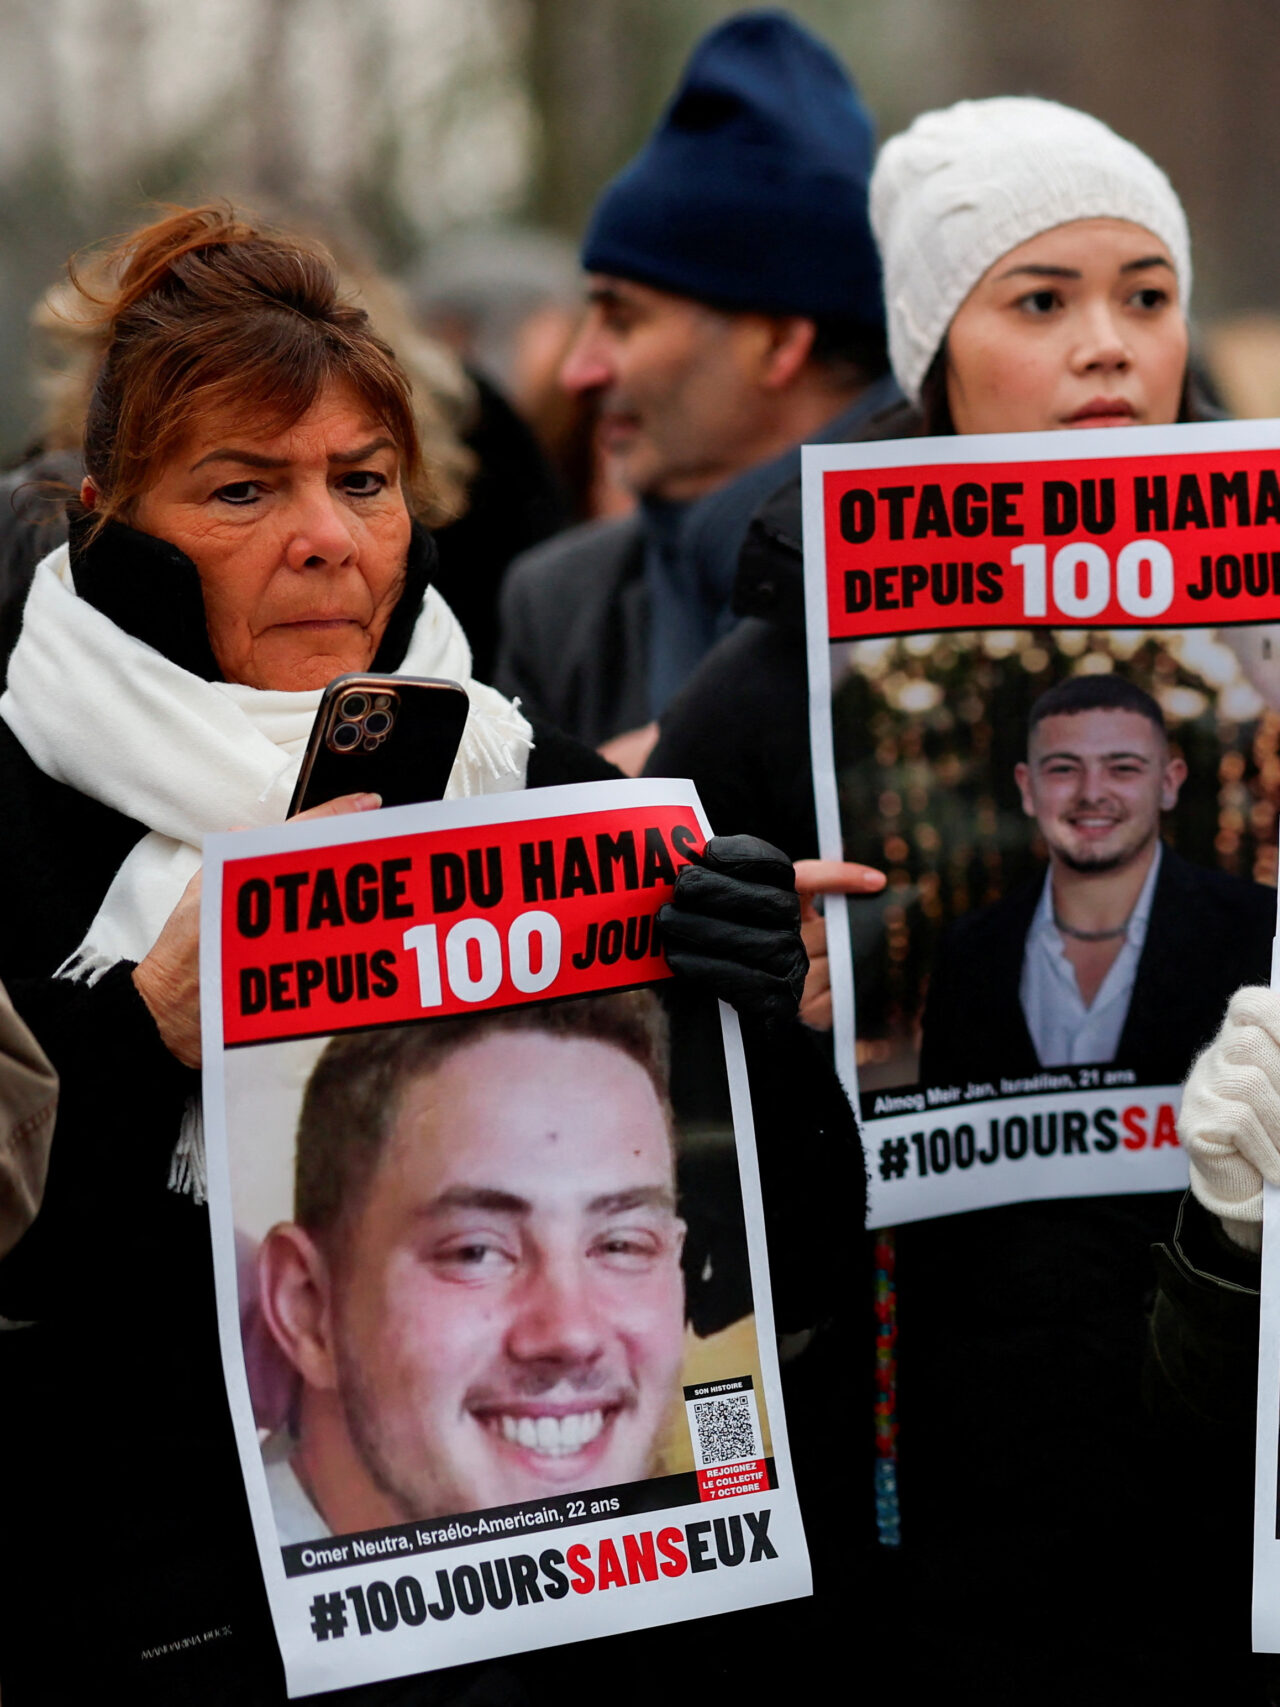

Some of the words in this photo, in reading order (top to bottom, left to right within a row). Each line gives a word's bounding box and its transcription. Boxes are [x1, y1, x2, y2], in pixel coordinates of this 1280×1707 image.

[840, 482, 1024, 544] OTAGE
[1043, 478, 1115, 536] DU
[844, 562, 1004, 614] DEPUIS
[1011, 539, 1174, 618] 100
[236, 857, 415, 938] OTAGE
[430, 846, 502, 915] DU
[239, 948, 399, 1016] DEPUIS
[403, 910, 562, 1009] 100
[571, 914, 668, 970] JOU
[874, 1093, 926, 1114] Almog
[1079, 1070, 1099, 1087] 21
[1103, 1070, 1136, 1085] ans
[878, 1104, 1181, 1181] #100JOURSSA
[711, 1382, 743, 1393] HISTOIRE
[703, 1481, 714, 1489] LE
[716, 1472, 763, 1487] COLLECTIF
[706, 1462, 757, 1478] REJOIGNEZ
[718, 1483, 760, 1496] OCTOBRE
[301, 1544, 348, 1569] Omer
[352, 1534, 413, 1559] Neutra,
[416, 1506, 563, 1547] Israélo-Americain,
[566, 1500, 586, 1518] 22
[590, 1496, 620, 1514] ans
[308, 1509, 779, 1642] #100JOURSSANSEUX
